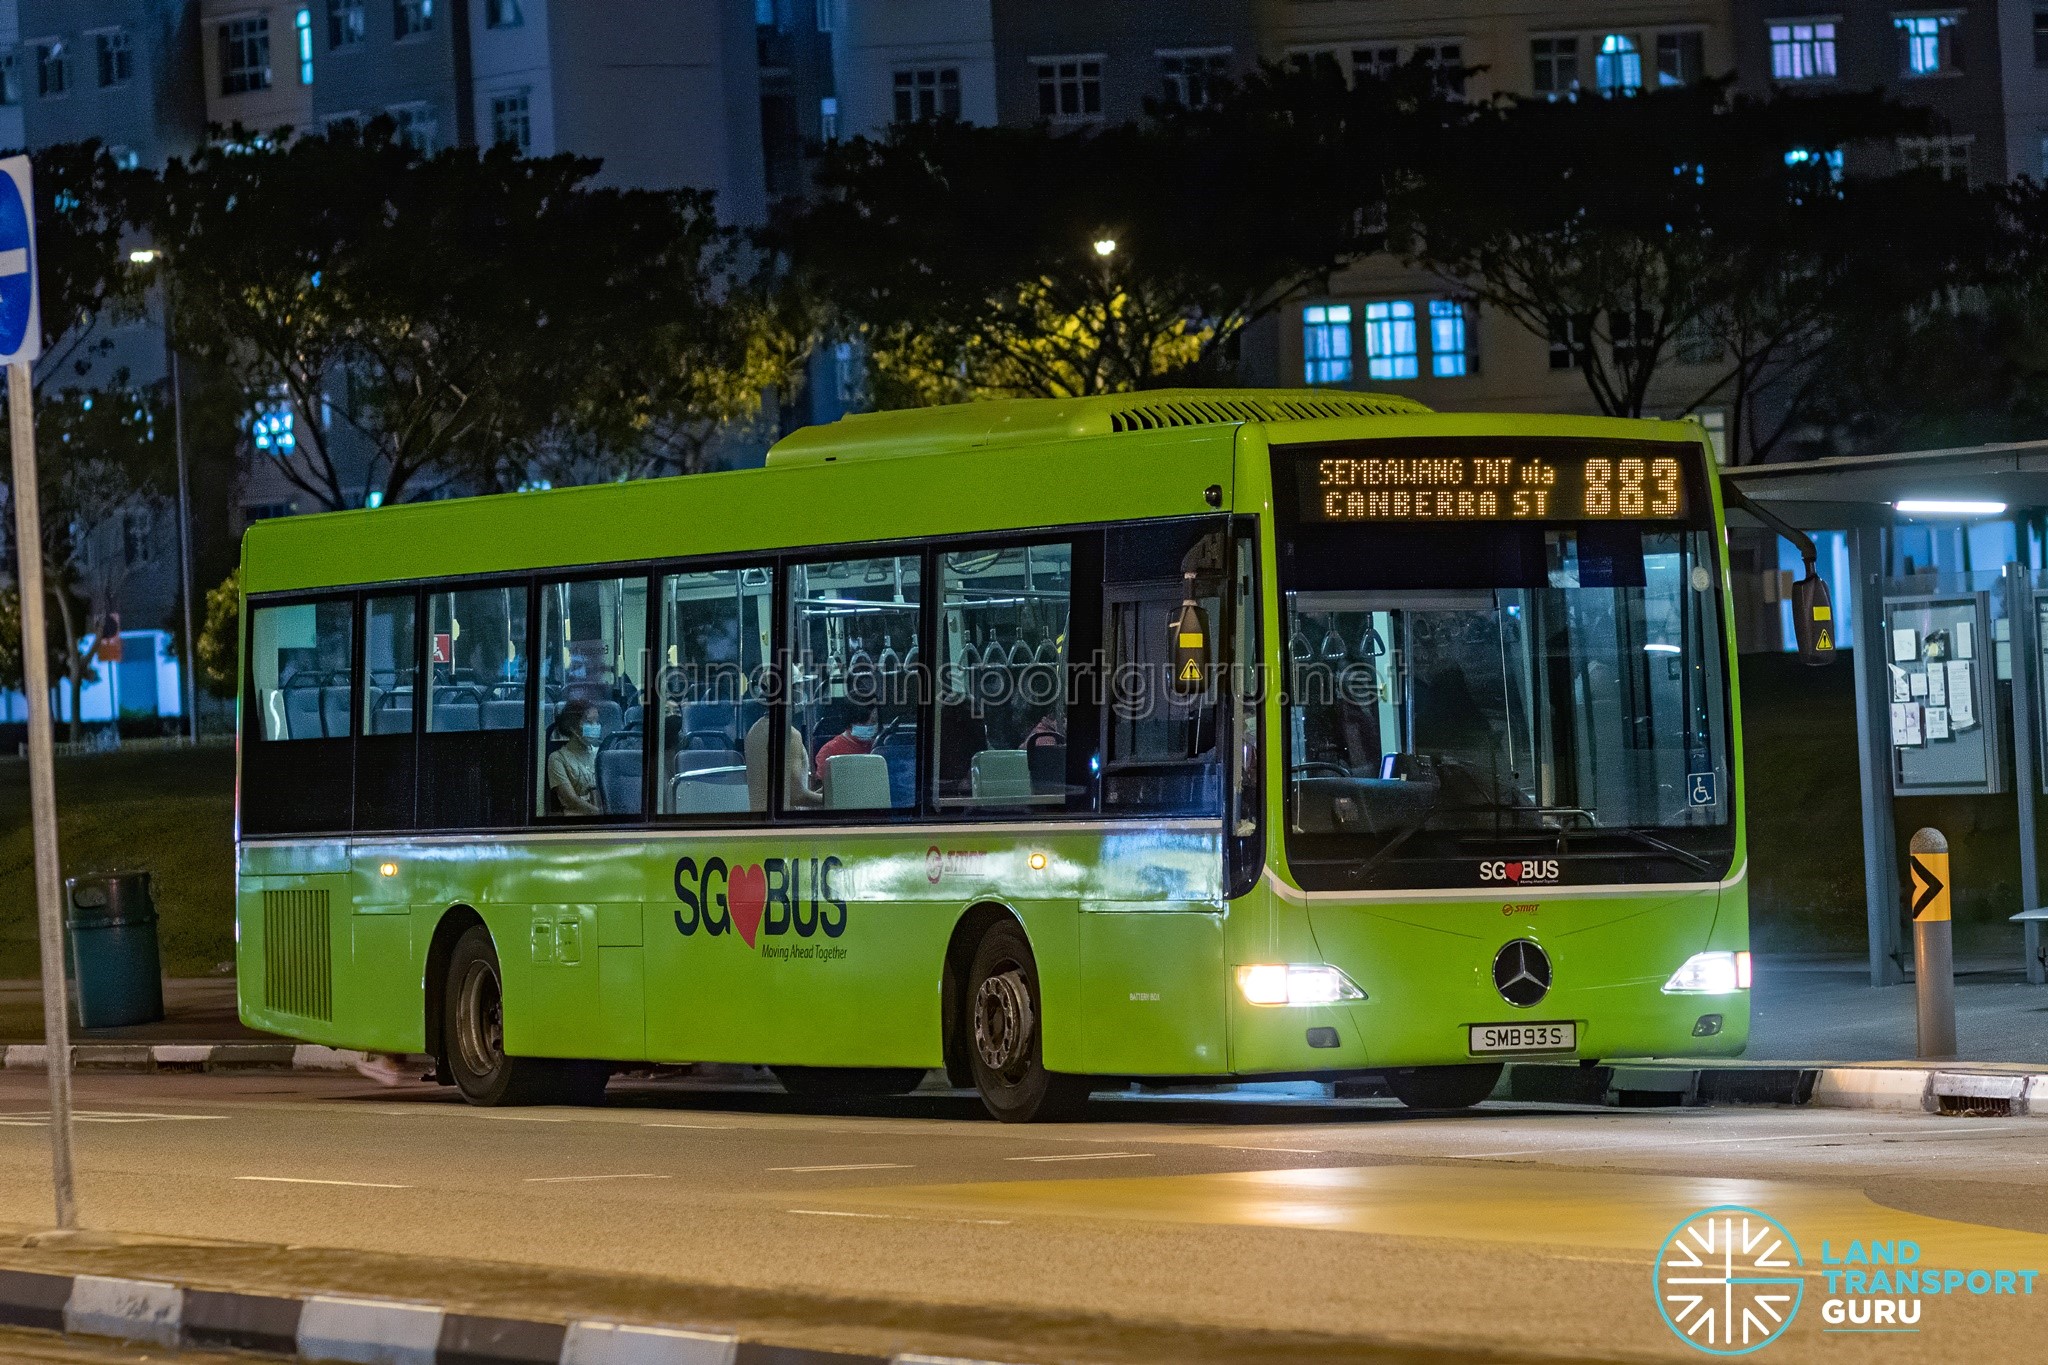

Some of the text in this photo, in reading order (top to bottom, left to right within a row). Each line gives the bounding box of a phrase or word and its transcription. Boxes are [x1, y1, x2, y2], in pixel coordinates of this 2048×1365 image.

[1319, 458, 1556, 486] SEMBAWANG INT via
[1584, 457, 1678, 516] 883
[1325, 490, 1549, 518] CANBERRA ST
[1521, 860, 1559, 879] BUS
[764, 856, 848, 938] BUS
[761, 944, 848, 963] Moving Ahead Together
